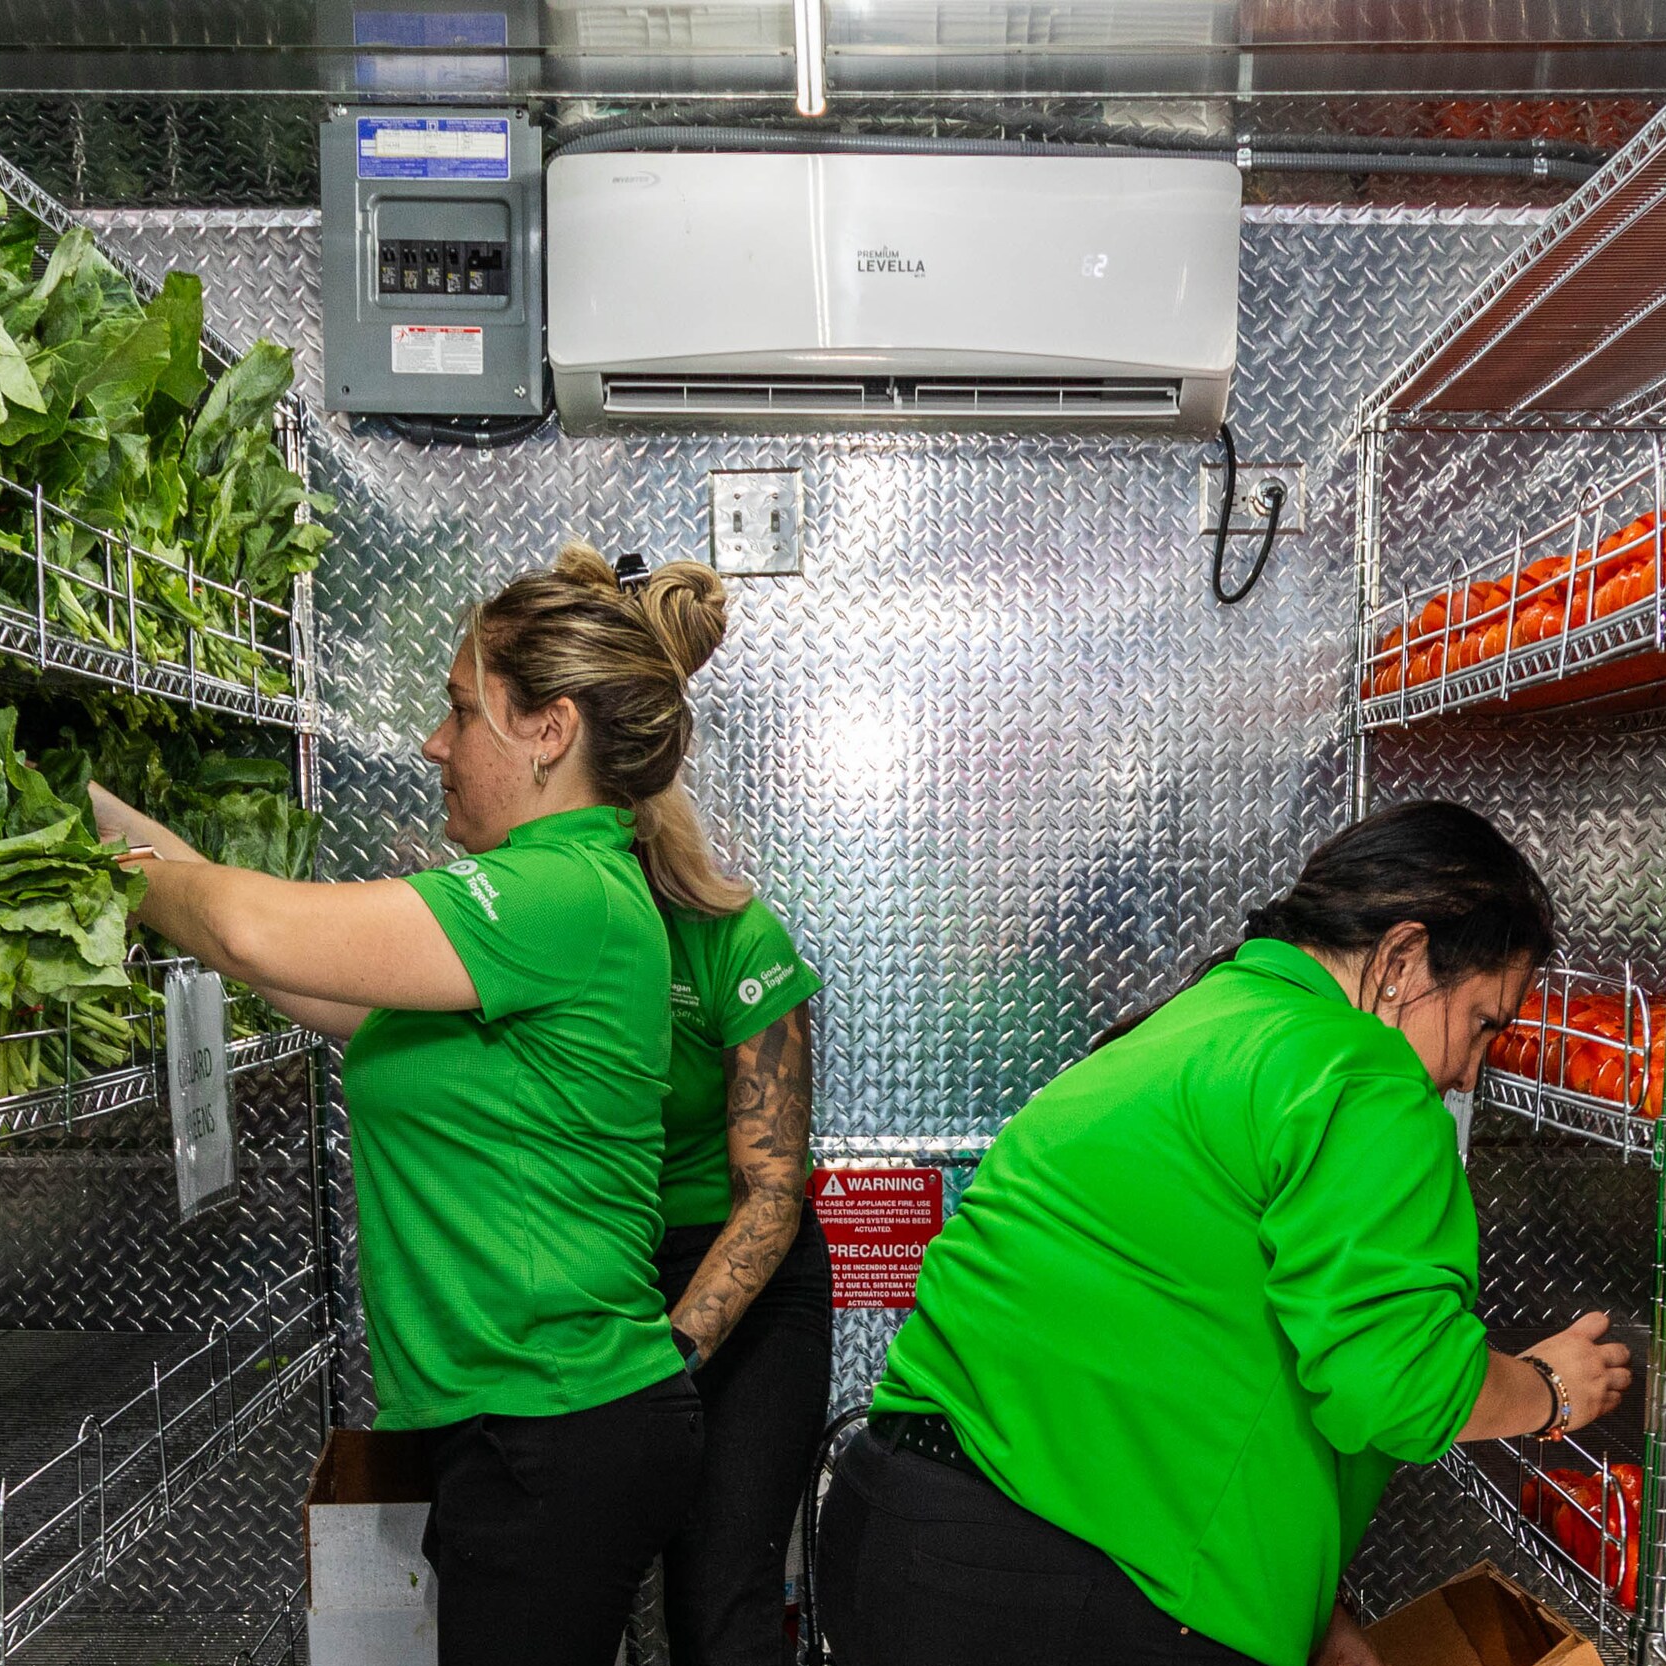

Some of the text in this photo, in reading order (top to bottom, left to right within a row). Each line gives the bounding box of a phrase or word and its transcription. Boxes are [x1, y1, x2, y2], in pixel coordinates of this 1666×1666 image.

[857, 250, 900, 259] PREMIUM
[857, 260, 925, 272] LEVELLA
[476, 872, 500, 899] Good
[467, 876, 499, 921] Together
[760, 961, 782, 980] Good
[764, 964, 794, 989] Together
[847, 1177, 924, 1191] WARNING
[844, 1289, 890, 1297] AUTOMÁTICO
